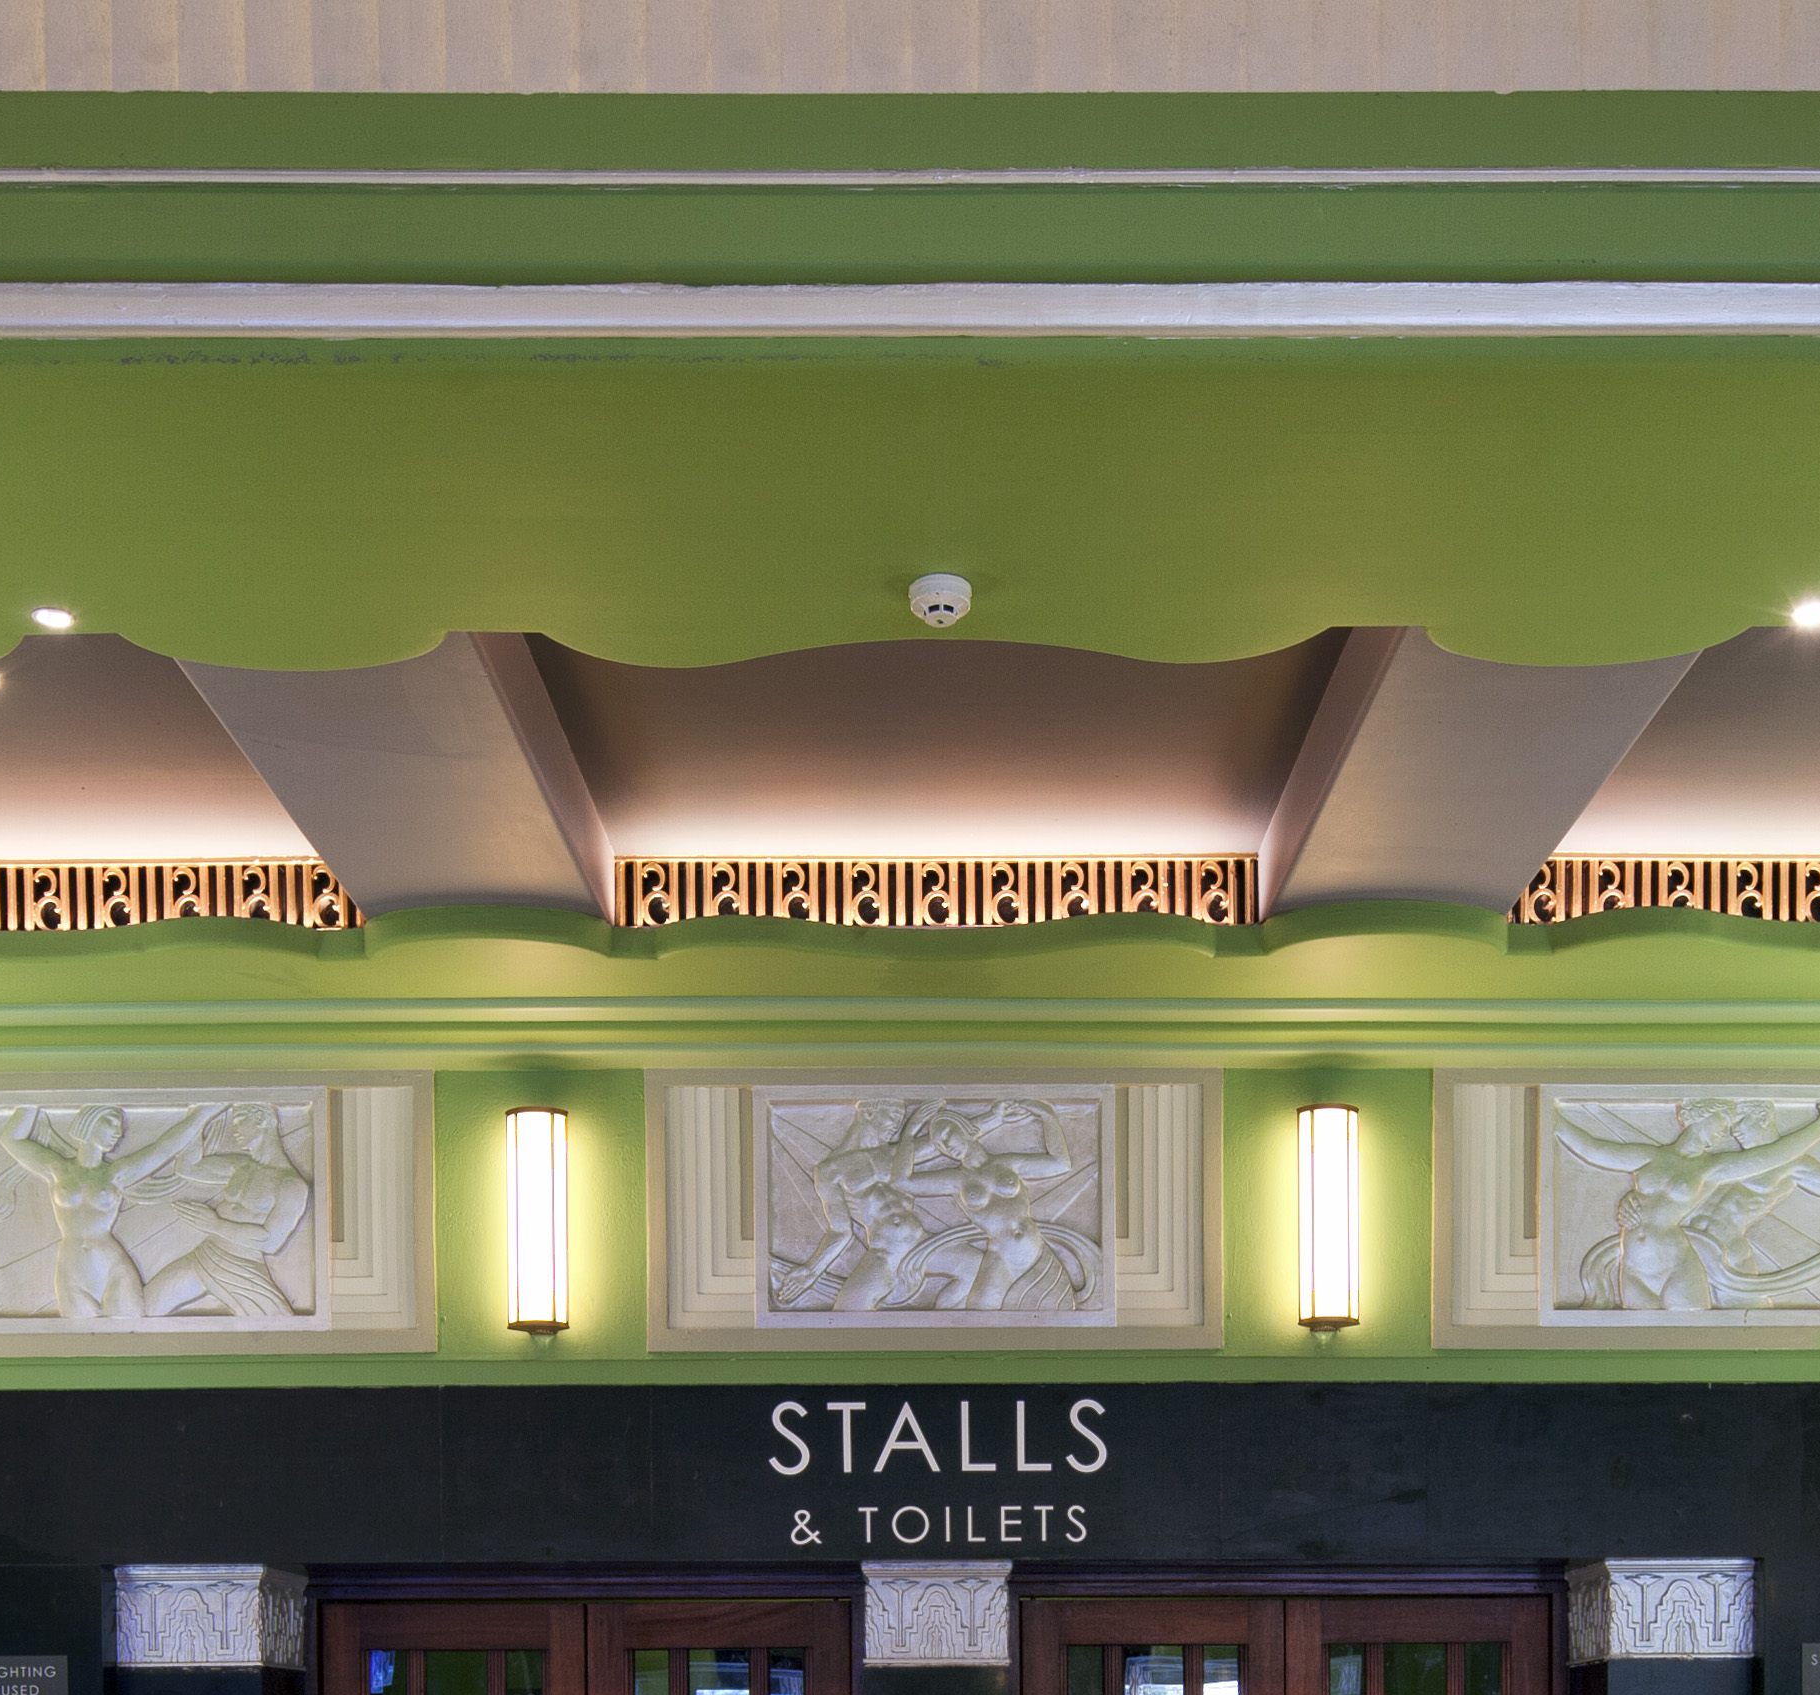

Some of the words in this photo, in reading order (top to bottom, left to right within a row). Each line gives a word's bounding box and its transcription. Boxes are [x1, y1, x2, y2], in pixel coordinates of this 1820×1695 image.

[768, 1399, 1108, 1476] STALLS
[790, 1509, 822, 1545] &
[858, 1505, 1087, 1544] TOILETS
